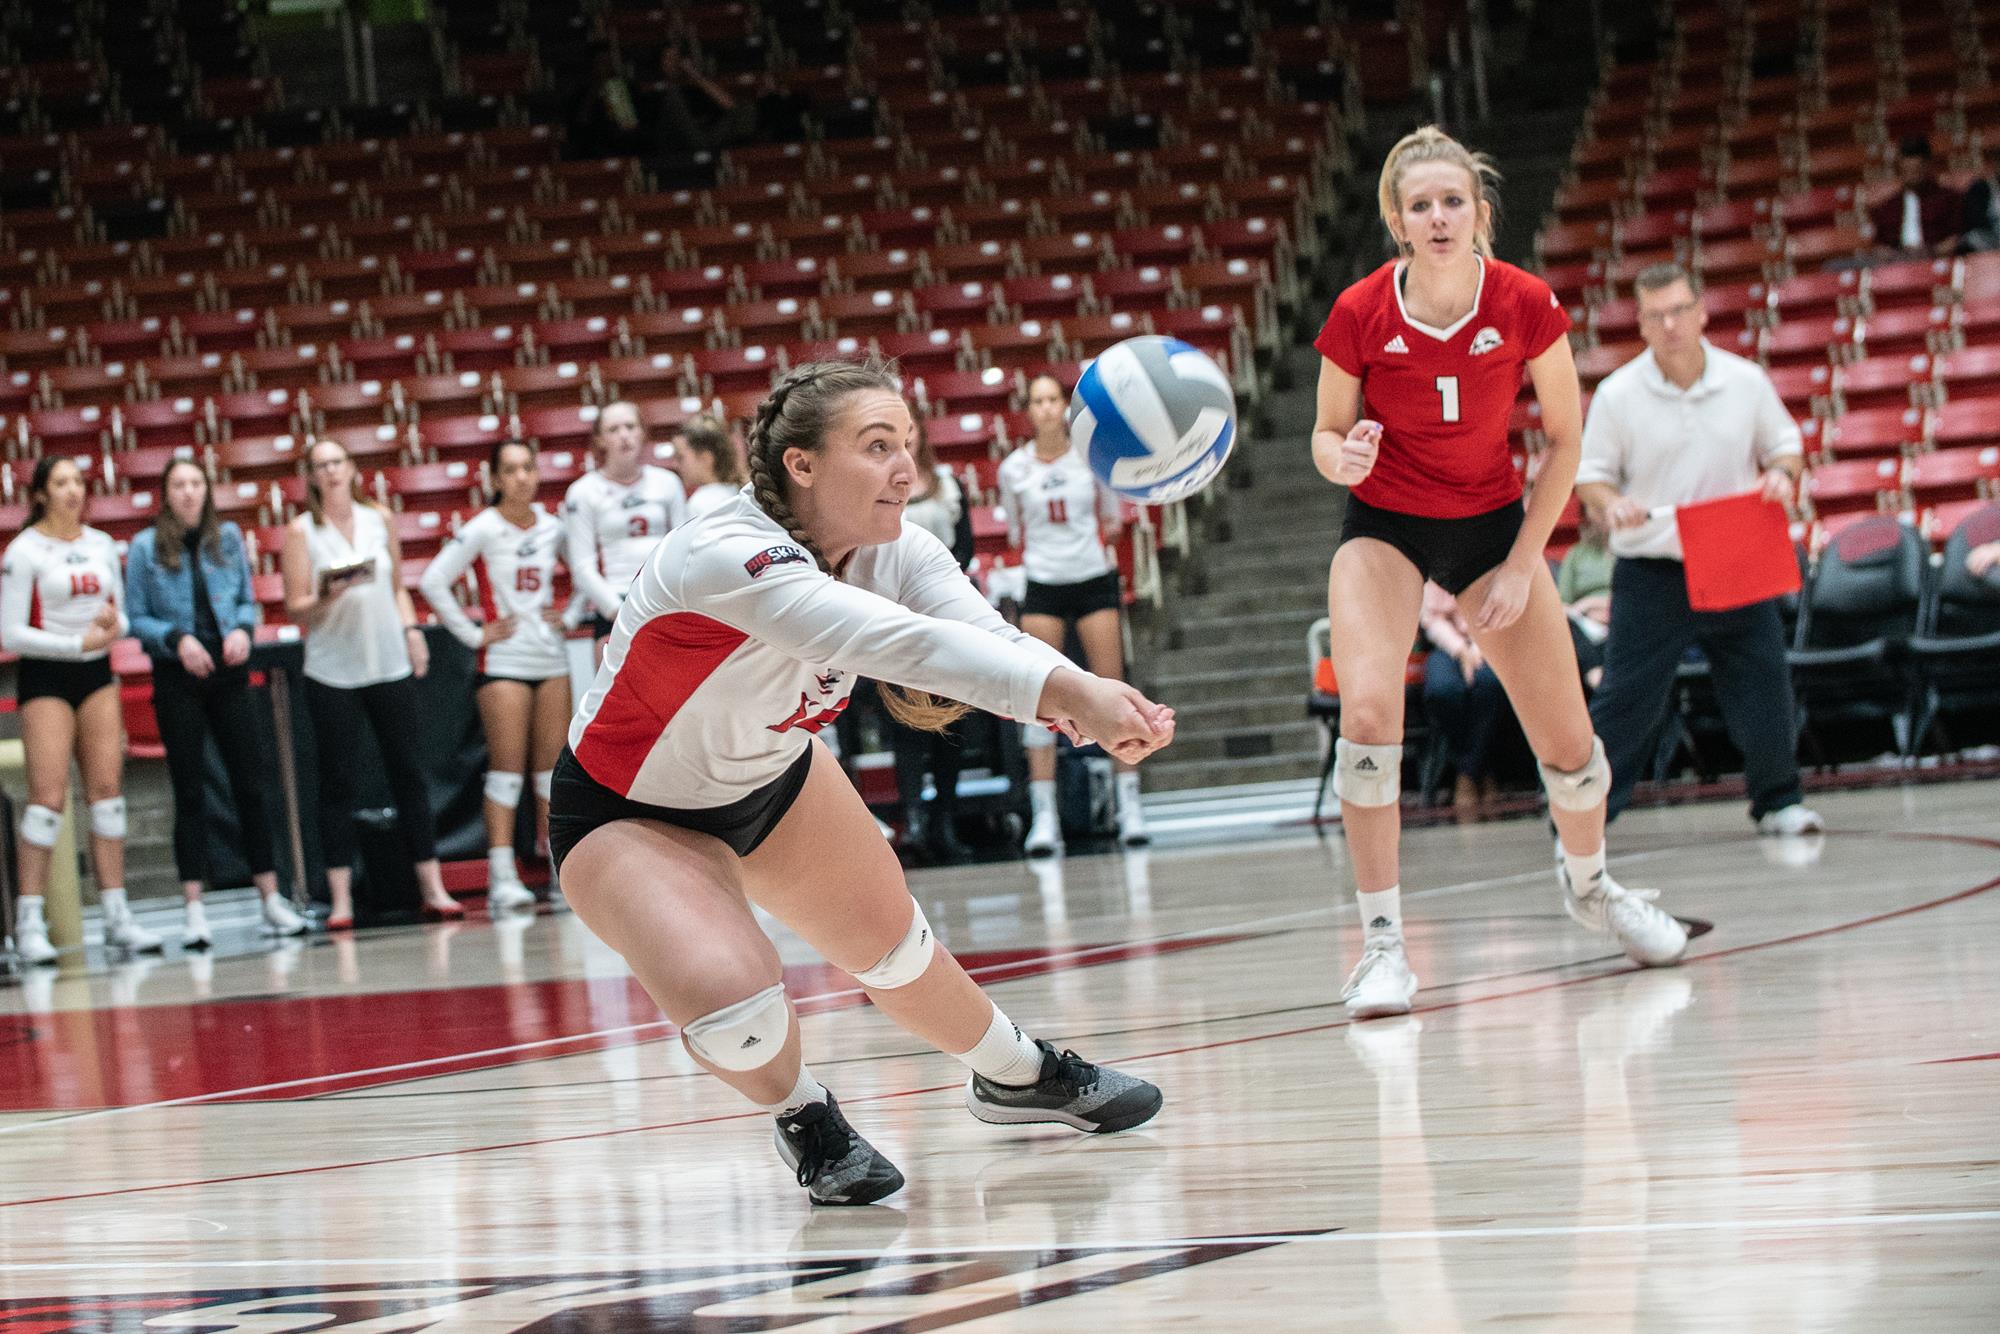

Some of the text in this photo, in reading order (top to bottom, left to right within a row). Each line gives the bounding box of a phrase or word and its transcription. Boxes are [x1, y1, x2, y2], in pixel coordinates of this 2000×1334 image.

[1435, 375, 1461, 422] 1
[1048, 498, 1067, 524] 11
[628, 515, 649, 537] 3
[515, 566, 541, 592] 15
